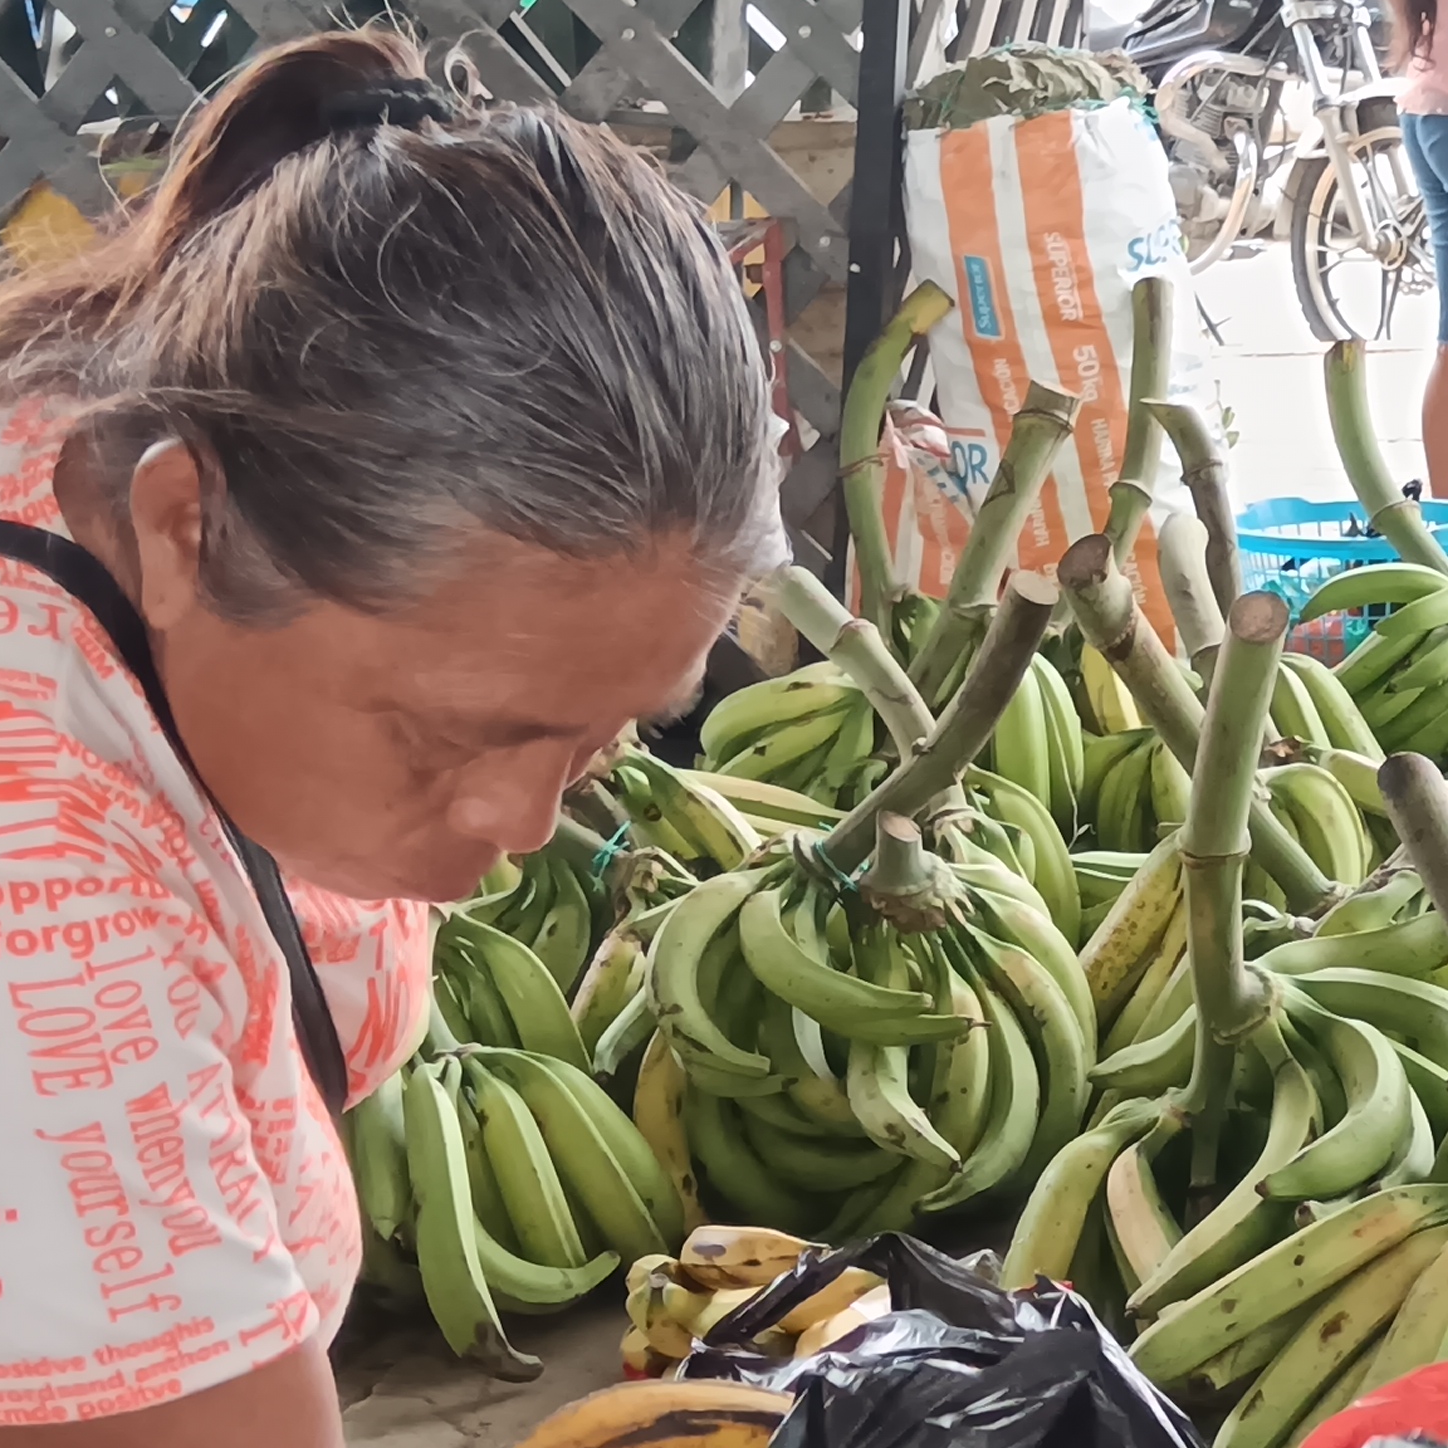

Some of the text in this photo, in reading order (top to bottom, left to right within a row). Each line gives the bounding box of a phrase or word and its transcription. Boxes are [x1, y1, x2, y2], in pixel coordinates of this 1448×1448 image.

[1043, 231, 1079, 322] SUPERIOR
[7, 970, 116, 1098] LOVE
[84, 945, 161, 1066] love
[34, 1119, 184, 1325] yourself
